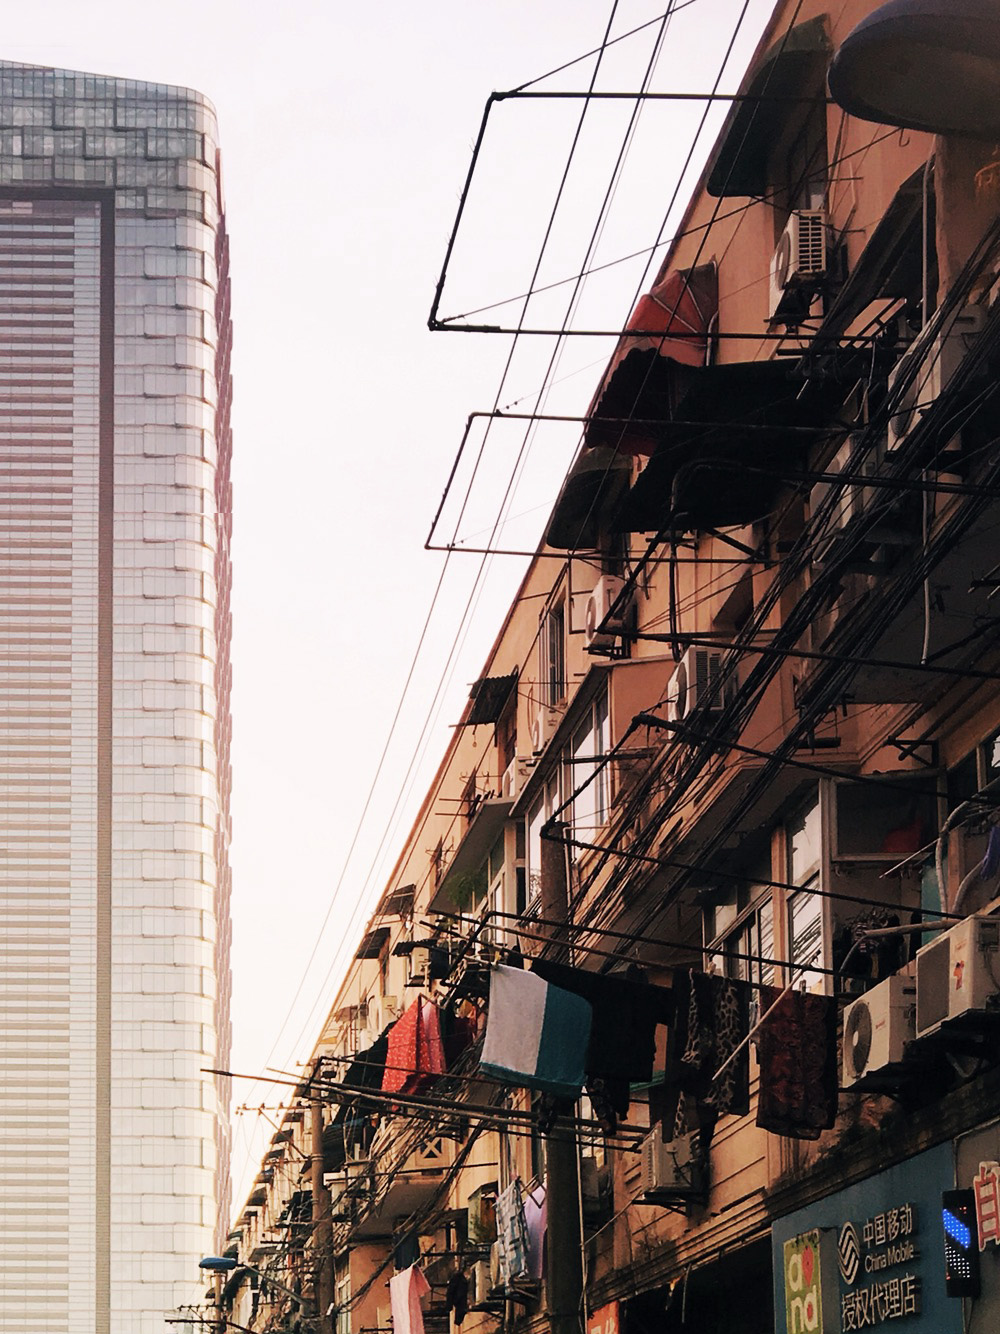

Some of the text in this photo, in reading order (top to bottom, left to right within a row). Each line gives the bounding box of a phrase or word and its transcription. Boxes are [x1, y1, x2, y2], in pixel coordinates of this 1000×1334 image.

[863, 1203, 913, 1249] 中国移动
[865, 1241, 914, 1274] China Mobile
[842, 1272, 916, 1333] 授权代理店
